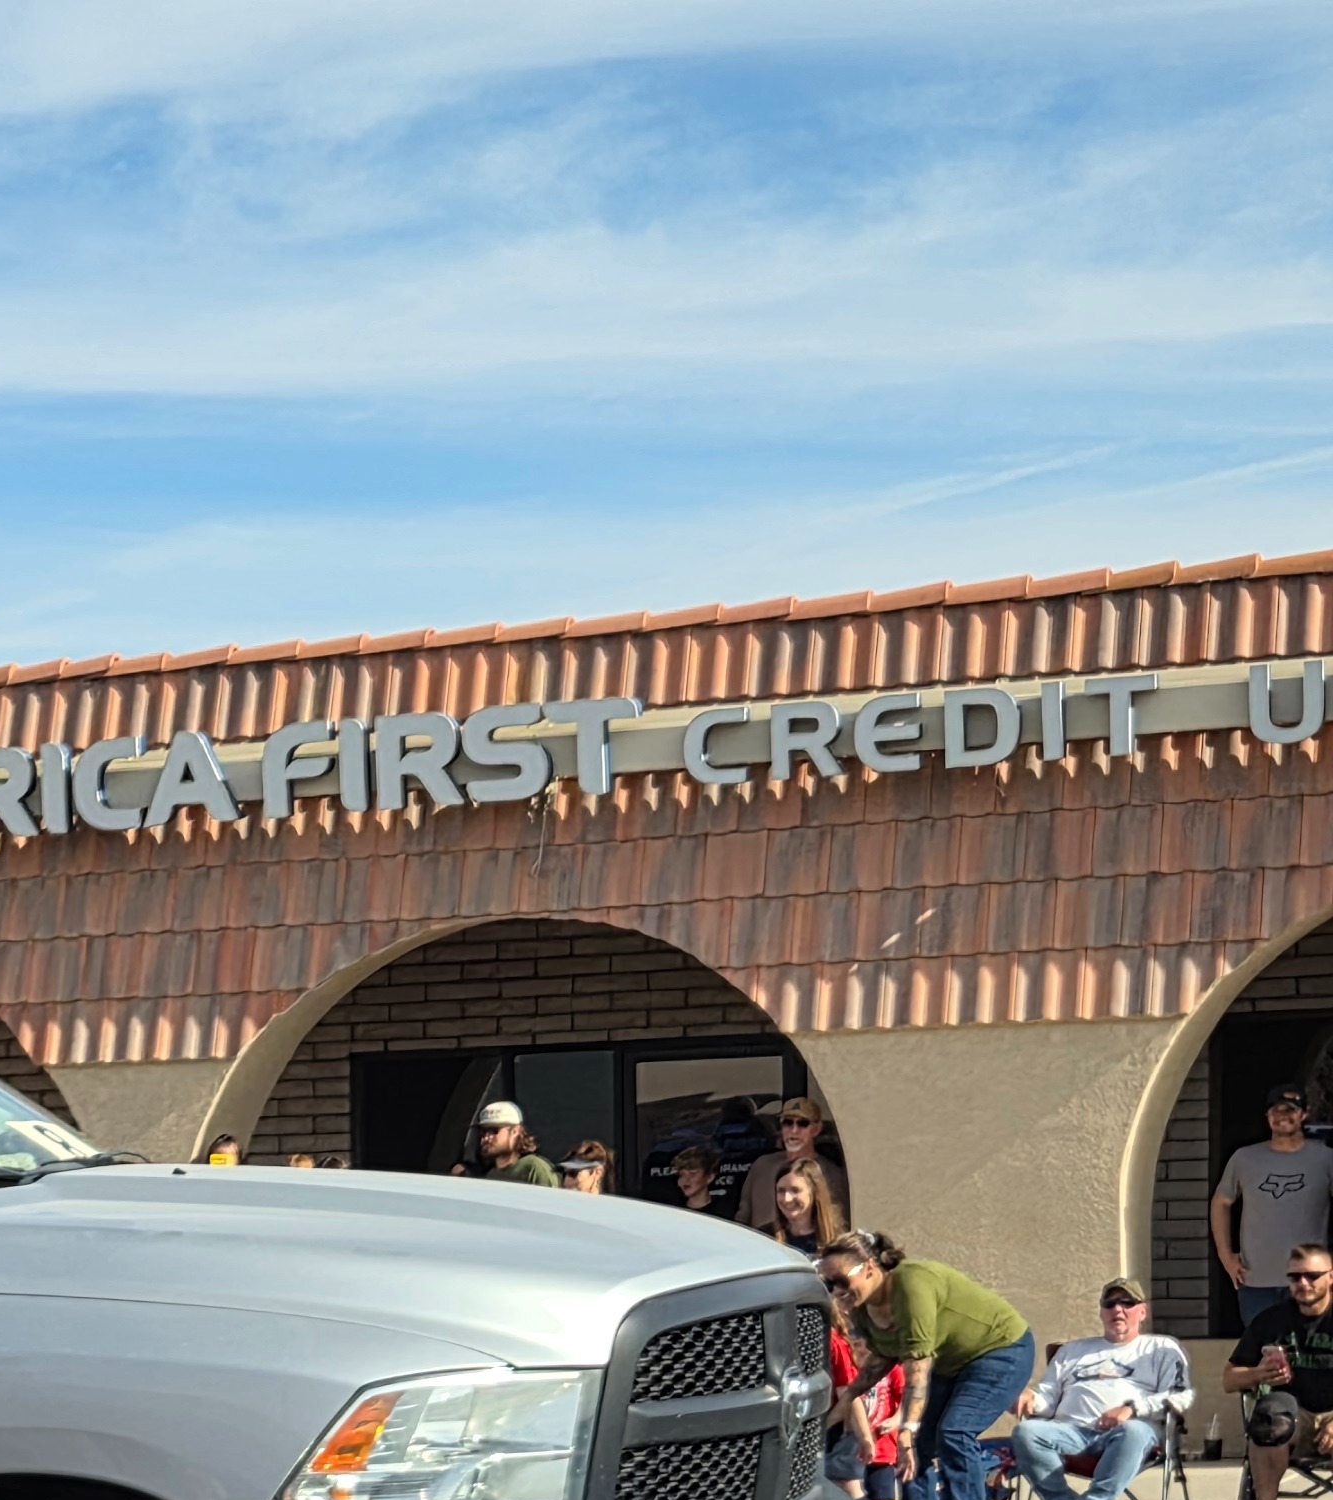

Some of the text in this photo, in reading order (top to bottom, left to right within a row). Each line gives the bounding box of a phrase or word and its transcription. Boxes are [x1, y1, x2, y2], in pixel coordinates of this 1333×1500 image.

[261, 697, 643, 819] FIRST
[683, 673, 1159, 785] CREDIT
[1248, 660, 1326, 745] U
